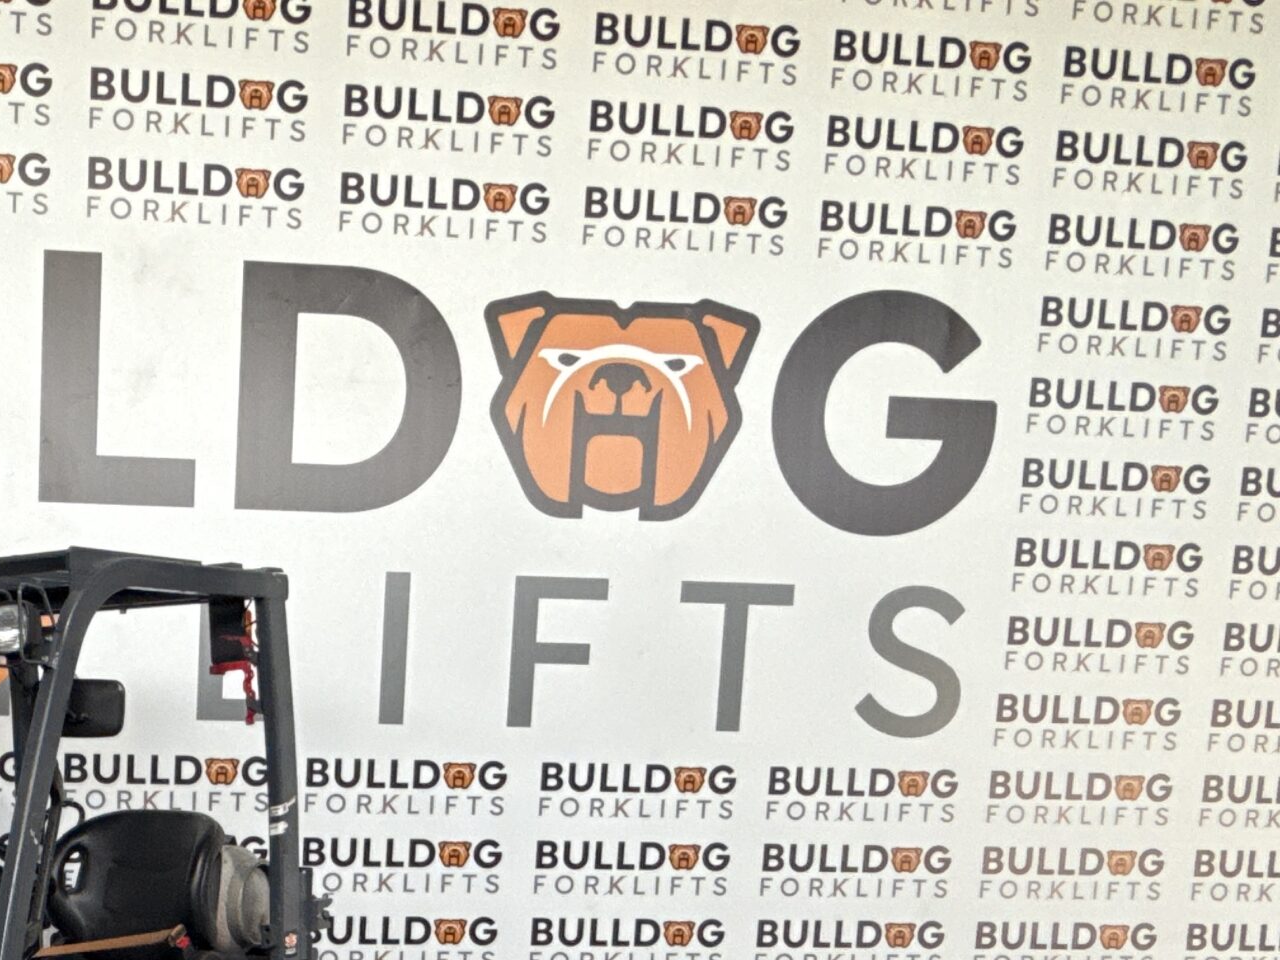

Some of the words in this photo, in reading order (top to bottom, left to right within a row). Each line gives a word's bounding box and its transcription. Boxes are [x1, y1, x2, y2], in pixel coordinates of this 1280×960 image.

[348, 0, 560, 42] BULLDG
[1072, 0, 1264, 34] FORKLIFTS
[91, 16, 309, 54] FORKLIFTS
[595, 12, 801, 58] BULLDG
[347, 34, 557, 70] FORKLIFTS
[592, 51, 796, 86] FORKLIFTS
[833, 29, 1032, 75] BULLDG
[1063, 45, 1256, 90] BULLDG
[90, 67, 308, 114] BULLDG
[831, 67, 1027, 102] FORKLIFTS
[1061, 83, 1251, 117] FORKLIFTS
[344, 84, 555, 130] BULLDG
[589, 99, 794, 144] BULLDG
[89, 107, 305, 142] FORKLIFTS
[343, 123, 552, 157] FORKLIFTS
[827, 115, 1024, 159] BULLDG
[587, 138, 790, 171] FORKLIFTS
[1055, 130, 1248, 173] BULLDG
[88, 156, 305, 202] BULLDG
[824, 153, 1020, 185] FORKLIFTS
[1053, 167, 1243, 199] FORKLIFTS
[340, 172, 550, 216] BULLDG
[584, 186, 788, 229] BULLDG
[87, 196, 301, 229] FORKLIFTS
[339, 211, 546, 243] FORKLIFTS
[820, 200, 1017, 242] BULLDG
[582, 224, 783, 256] FORKLIFTS
[1048, 213, 1239, 255] BULLDG
[818, 238, 1012, 269] FORKLIFTS
[1045, 250, 1235, 281] FORKLIFTS
[1040, 296, 1231, 336] BULLDG
[1037, 333, 1226, 361] FORKLIFTS
[1029, 377, 1219, 416] BULLDG
[1027, 413, 1214, 441] FORKLIFTS
[1022, 458, 1211, 495] BULLDG
[1019, 493, 1206, 520] FORKLIFTS
[1014, 537, 1203, 573] BULLDG
[1012, 573, 1198, 598] FORKLIFTS
[1007, 616, 1194, 651] BULLDG
[1005, 651, 1189, 675] FORKLIFTS
[996, 693, 1181, 727] BULLDG
[994, 728, 1176, 751] FORKLIFTS
[63, 752, 268, 787] BULLDG
[305, 757, 508, 791] BULLDG
[540, 762, 737, 795] BULLDG
[768, 766, 958, 799] BULLDG
[989, 770, 1173, 802] BULLDG
[304, 793, 504, 816] FORKLIFTS
[539, 797, 733, 820] FORKLIFTS
[766, 801, 954, 823] FORKLIFTS
[986, 805, 1168, 826] FORKLIFTS
[303, 836, 503, 869] BULLDG
[535, 840, 731, 872] BULLDG
[762, 843, 952, 874] BULLDG
[982, 846, 1165, 877] BULLDG
[534, 875, 727, 896] FORKLIFTS
[760, 877, 947, 898] FORKLIFTS
[979, 880, 1160, 901] FORKLIFTS
[530, 917, 725, 948] BULLDG
[756, 919, 945, 950] BULLDG
[975, 921, 1157, 951] BULLDG
